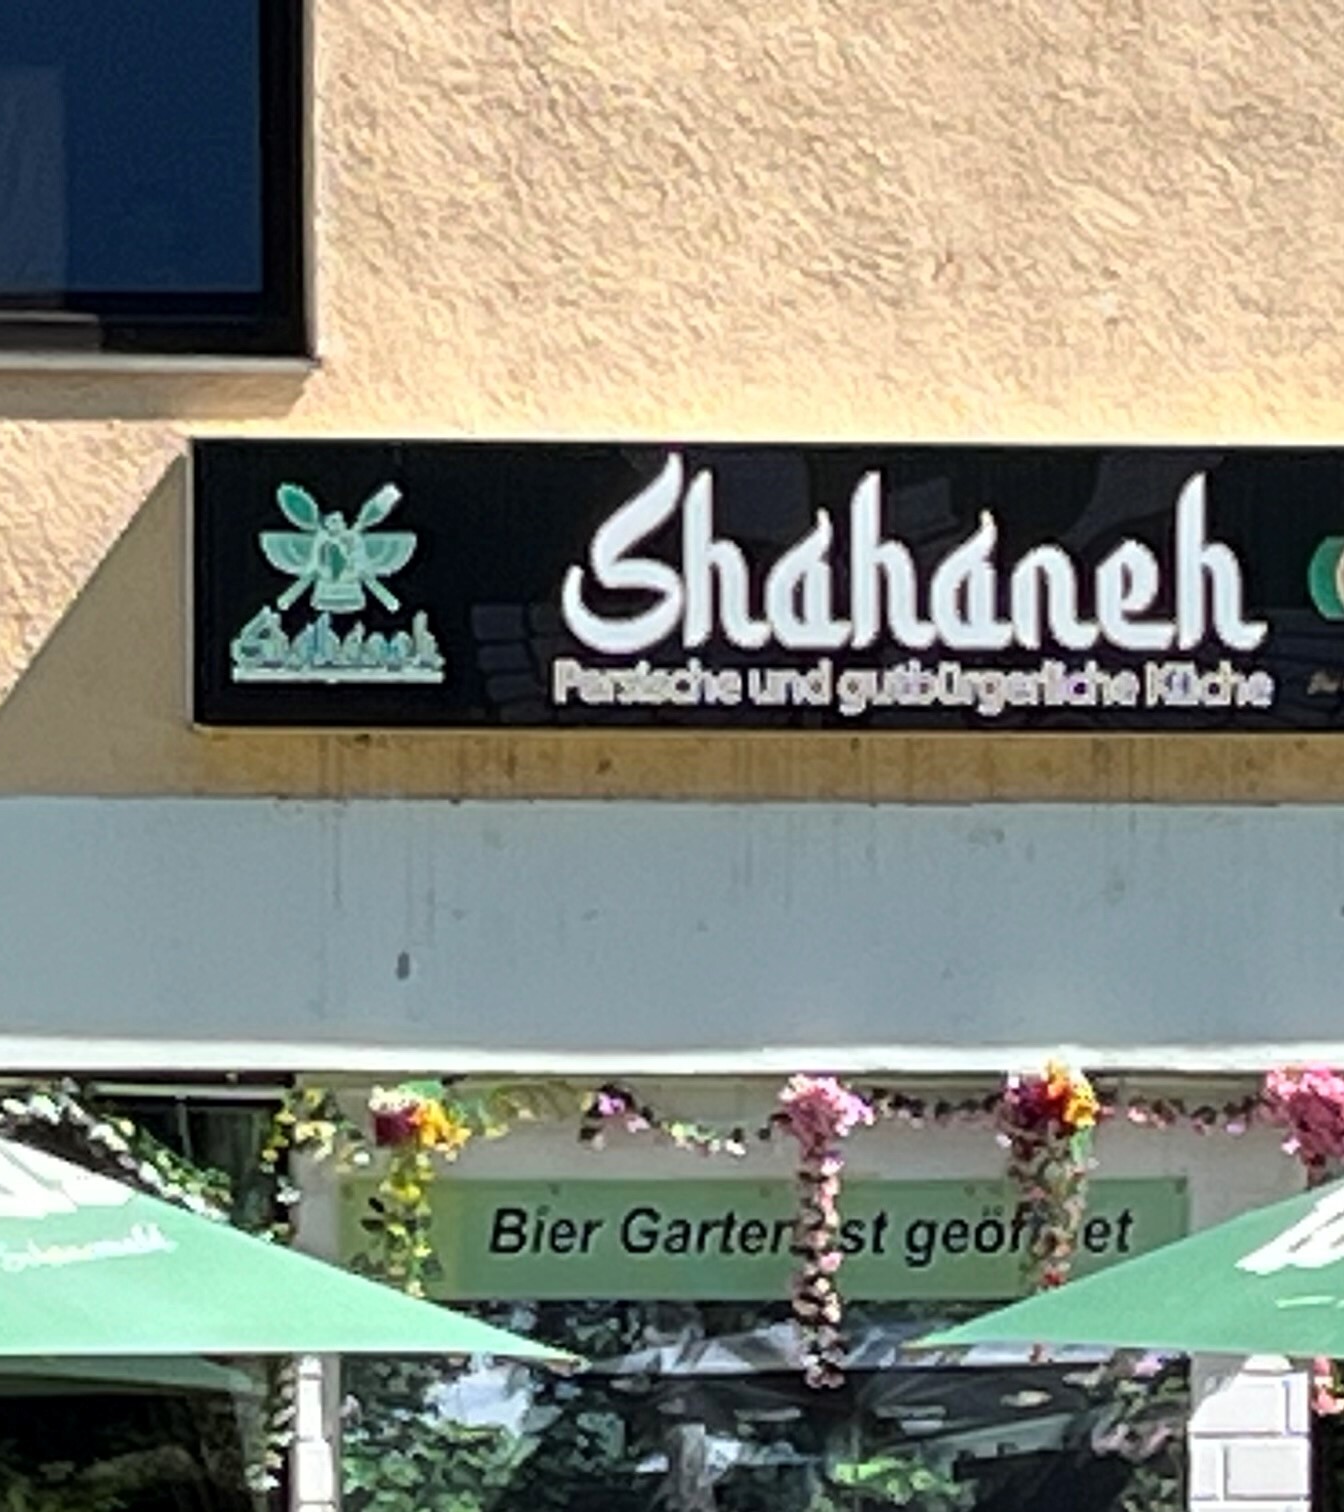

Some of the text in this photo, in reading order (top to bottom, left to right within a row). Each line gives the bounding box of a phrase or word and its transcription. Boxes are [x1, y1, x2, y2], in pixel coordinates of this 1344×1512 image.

[562, 450, 1268, 654] Shahaneh
[554, 658, 743, 706] Persische
[748, 658, 833, 706] und
[836, 659, 1140, 716] gutbürgerliche
[1145, 660, 1274, 707] Küche
[489, 1205, 604, 1254] Bier
[826, 1209, 889, 1255] st
[905, 1202, 1134, 1268] geöfet
